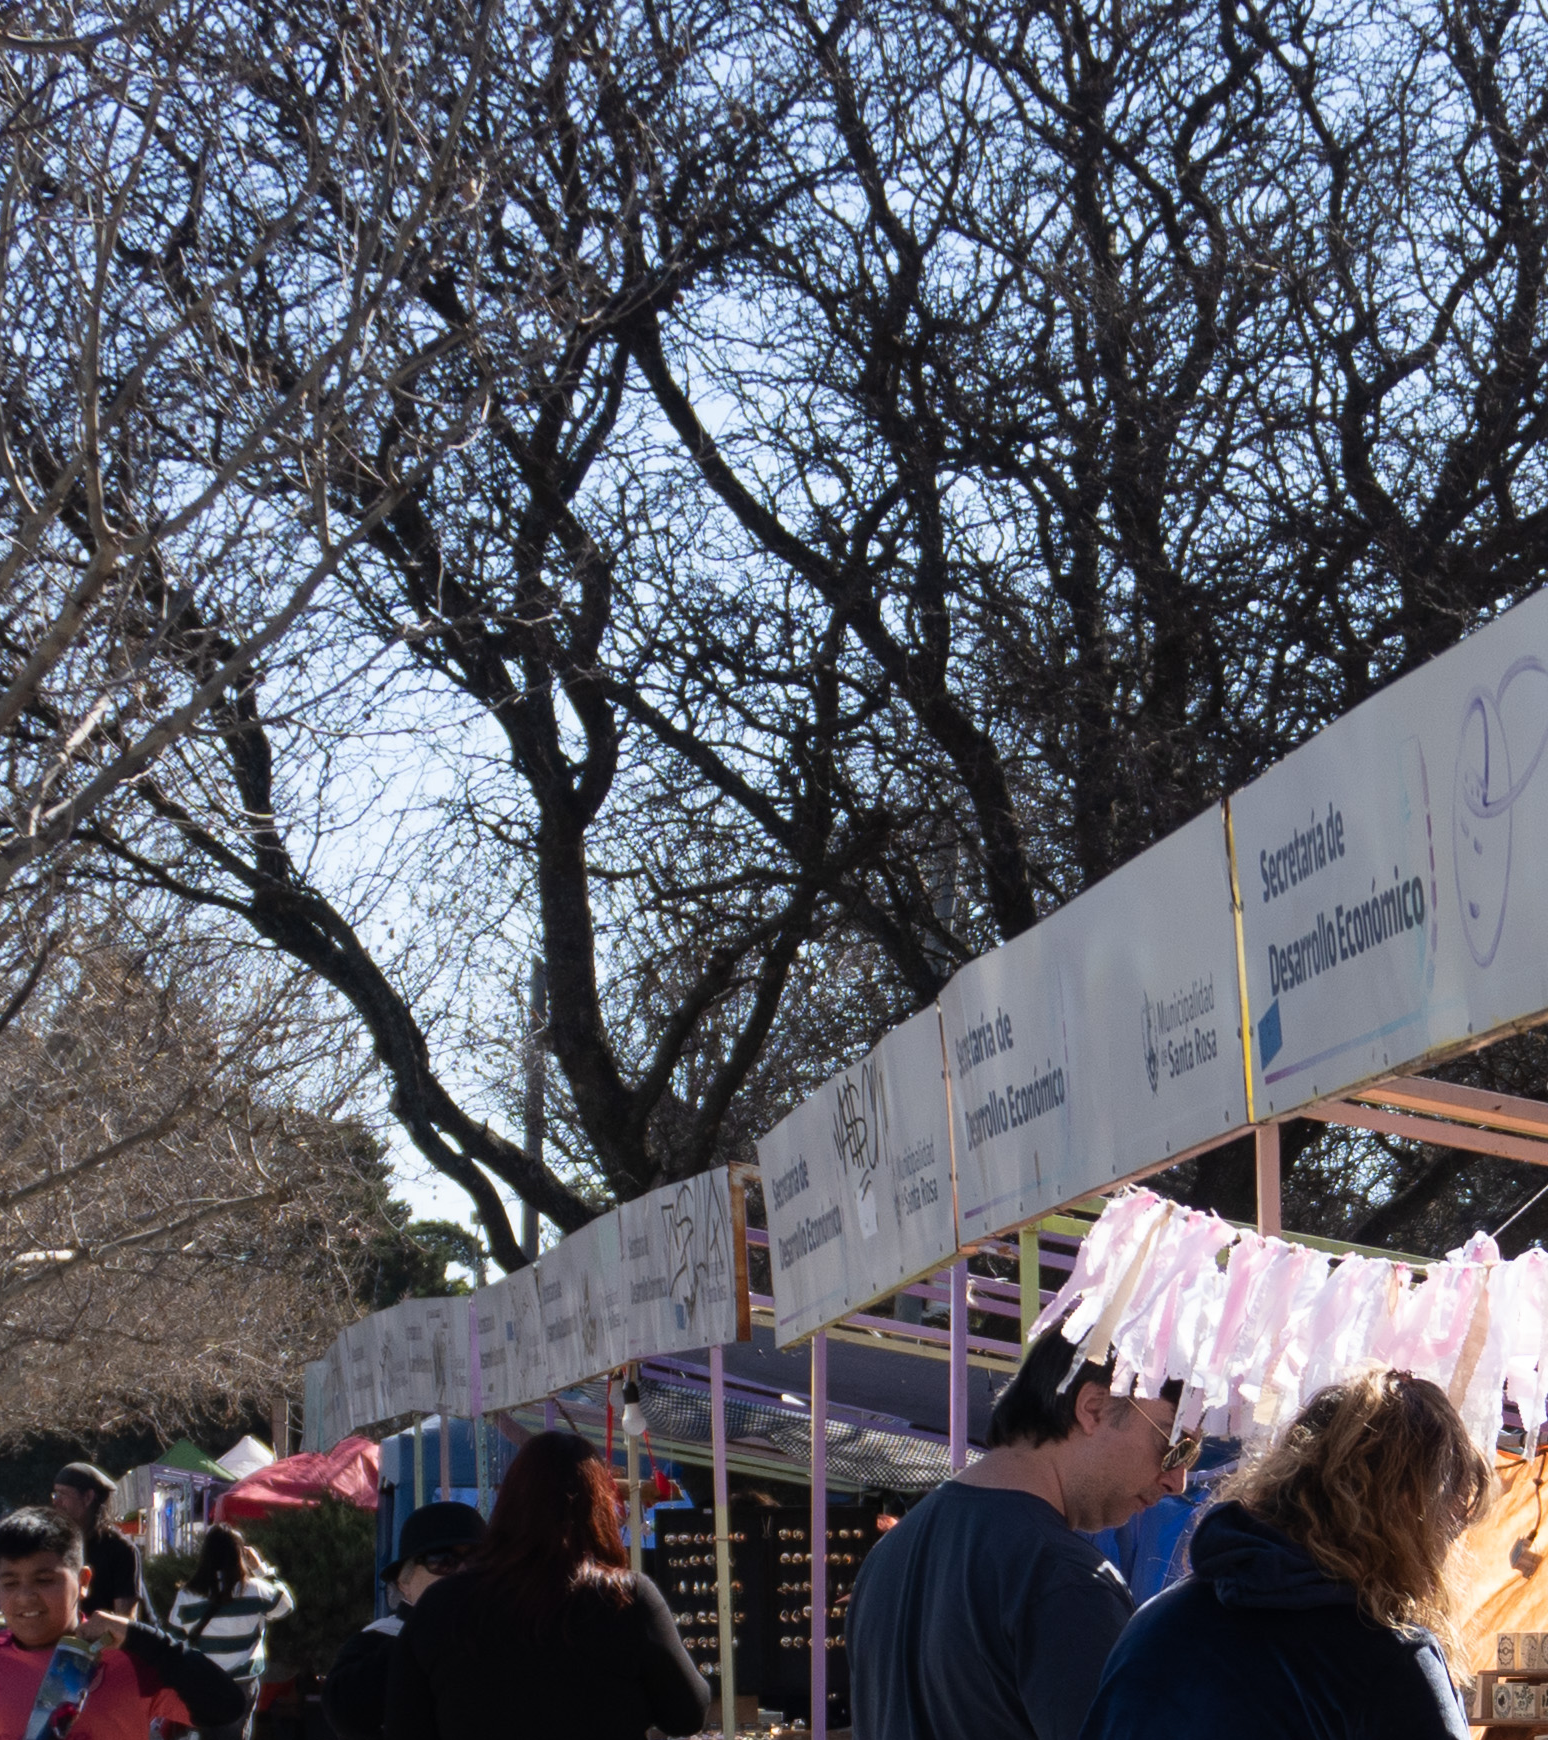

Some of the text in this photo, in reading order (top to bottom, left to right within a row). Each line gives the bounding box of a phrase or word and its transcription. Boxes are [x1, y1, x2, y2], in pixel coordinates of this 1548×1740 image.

[1260, 801, 1345, 903] Secretaría de
[1268, 864, 1425, 997] Desarrollo Económico
[996, 1006, 1014, 1053] de
[1157, 971, 1215, 1036] Municipalidad
[1168, 1035, 1194, 1079] Santa
[1195, 1027, 1217, 1065] Rosa
[1006, 1057, 1066, 1128] Económico
